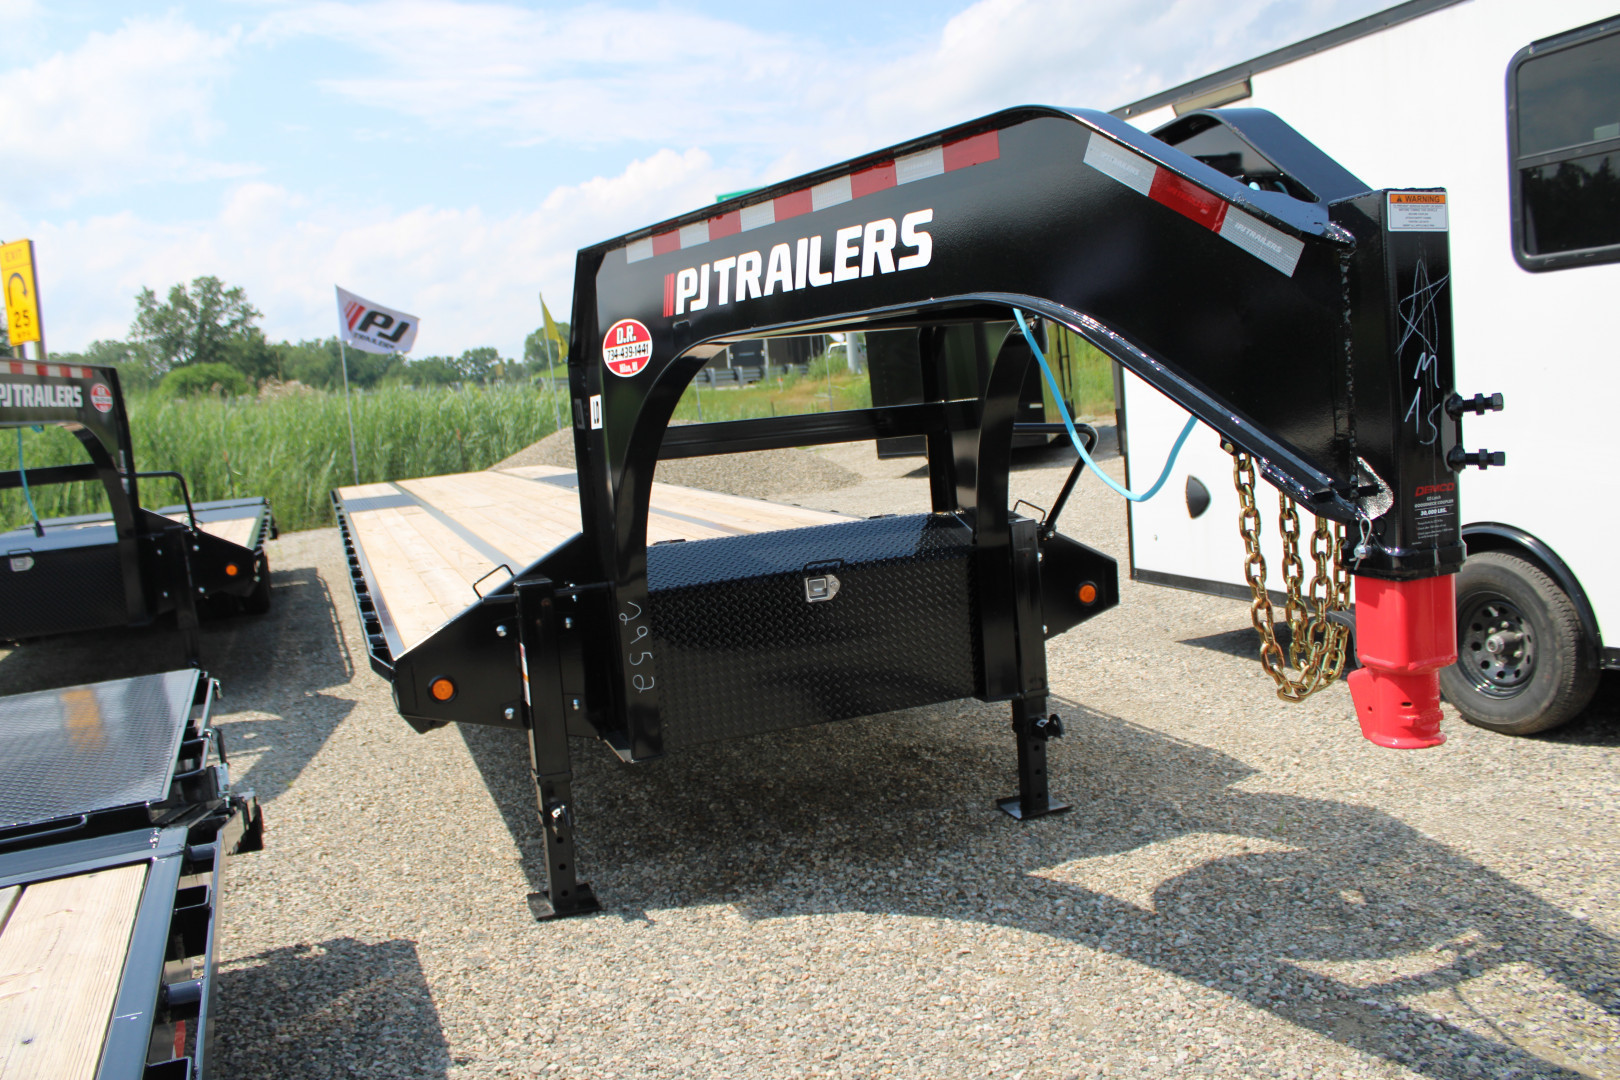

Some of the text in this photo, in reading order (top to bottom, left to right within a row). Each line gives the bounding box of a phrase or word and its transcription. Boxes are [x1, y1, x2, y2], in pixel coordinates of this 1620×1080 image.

[1405, 195, 1440, 203] WARNING
[14, 309, 31, 329] 25
[357, 310, 410, 343] PJ
[616, 325, 637, 345] D.R.
[607, 343, 649, 361] 734-439-1441
[1415, 482, 1455, 497] DEMCO
